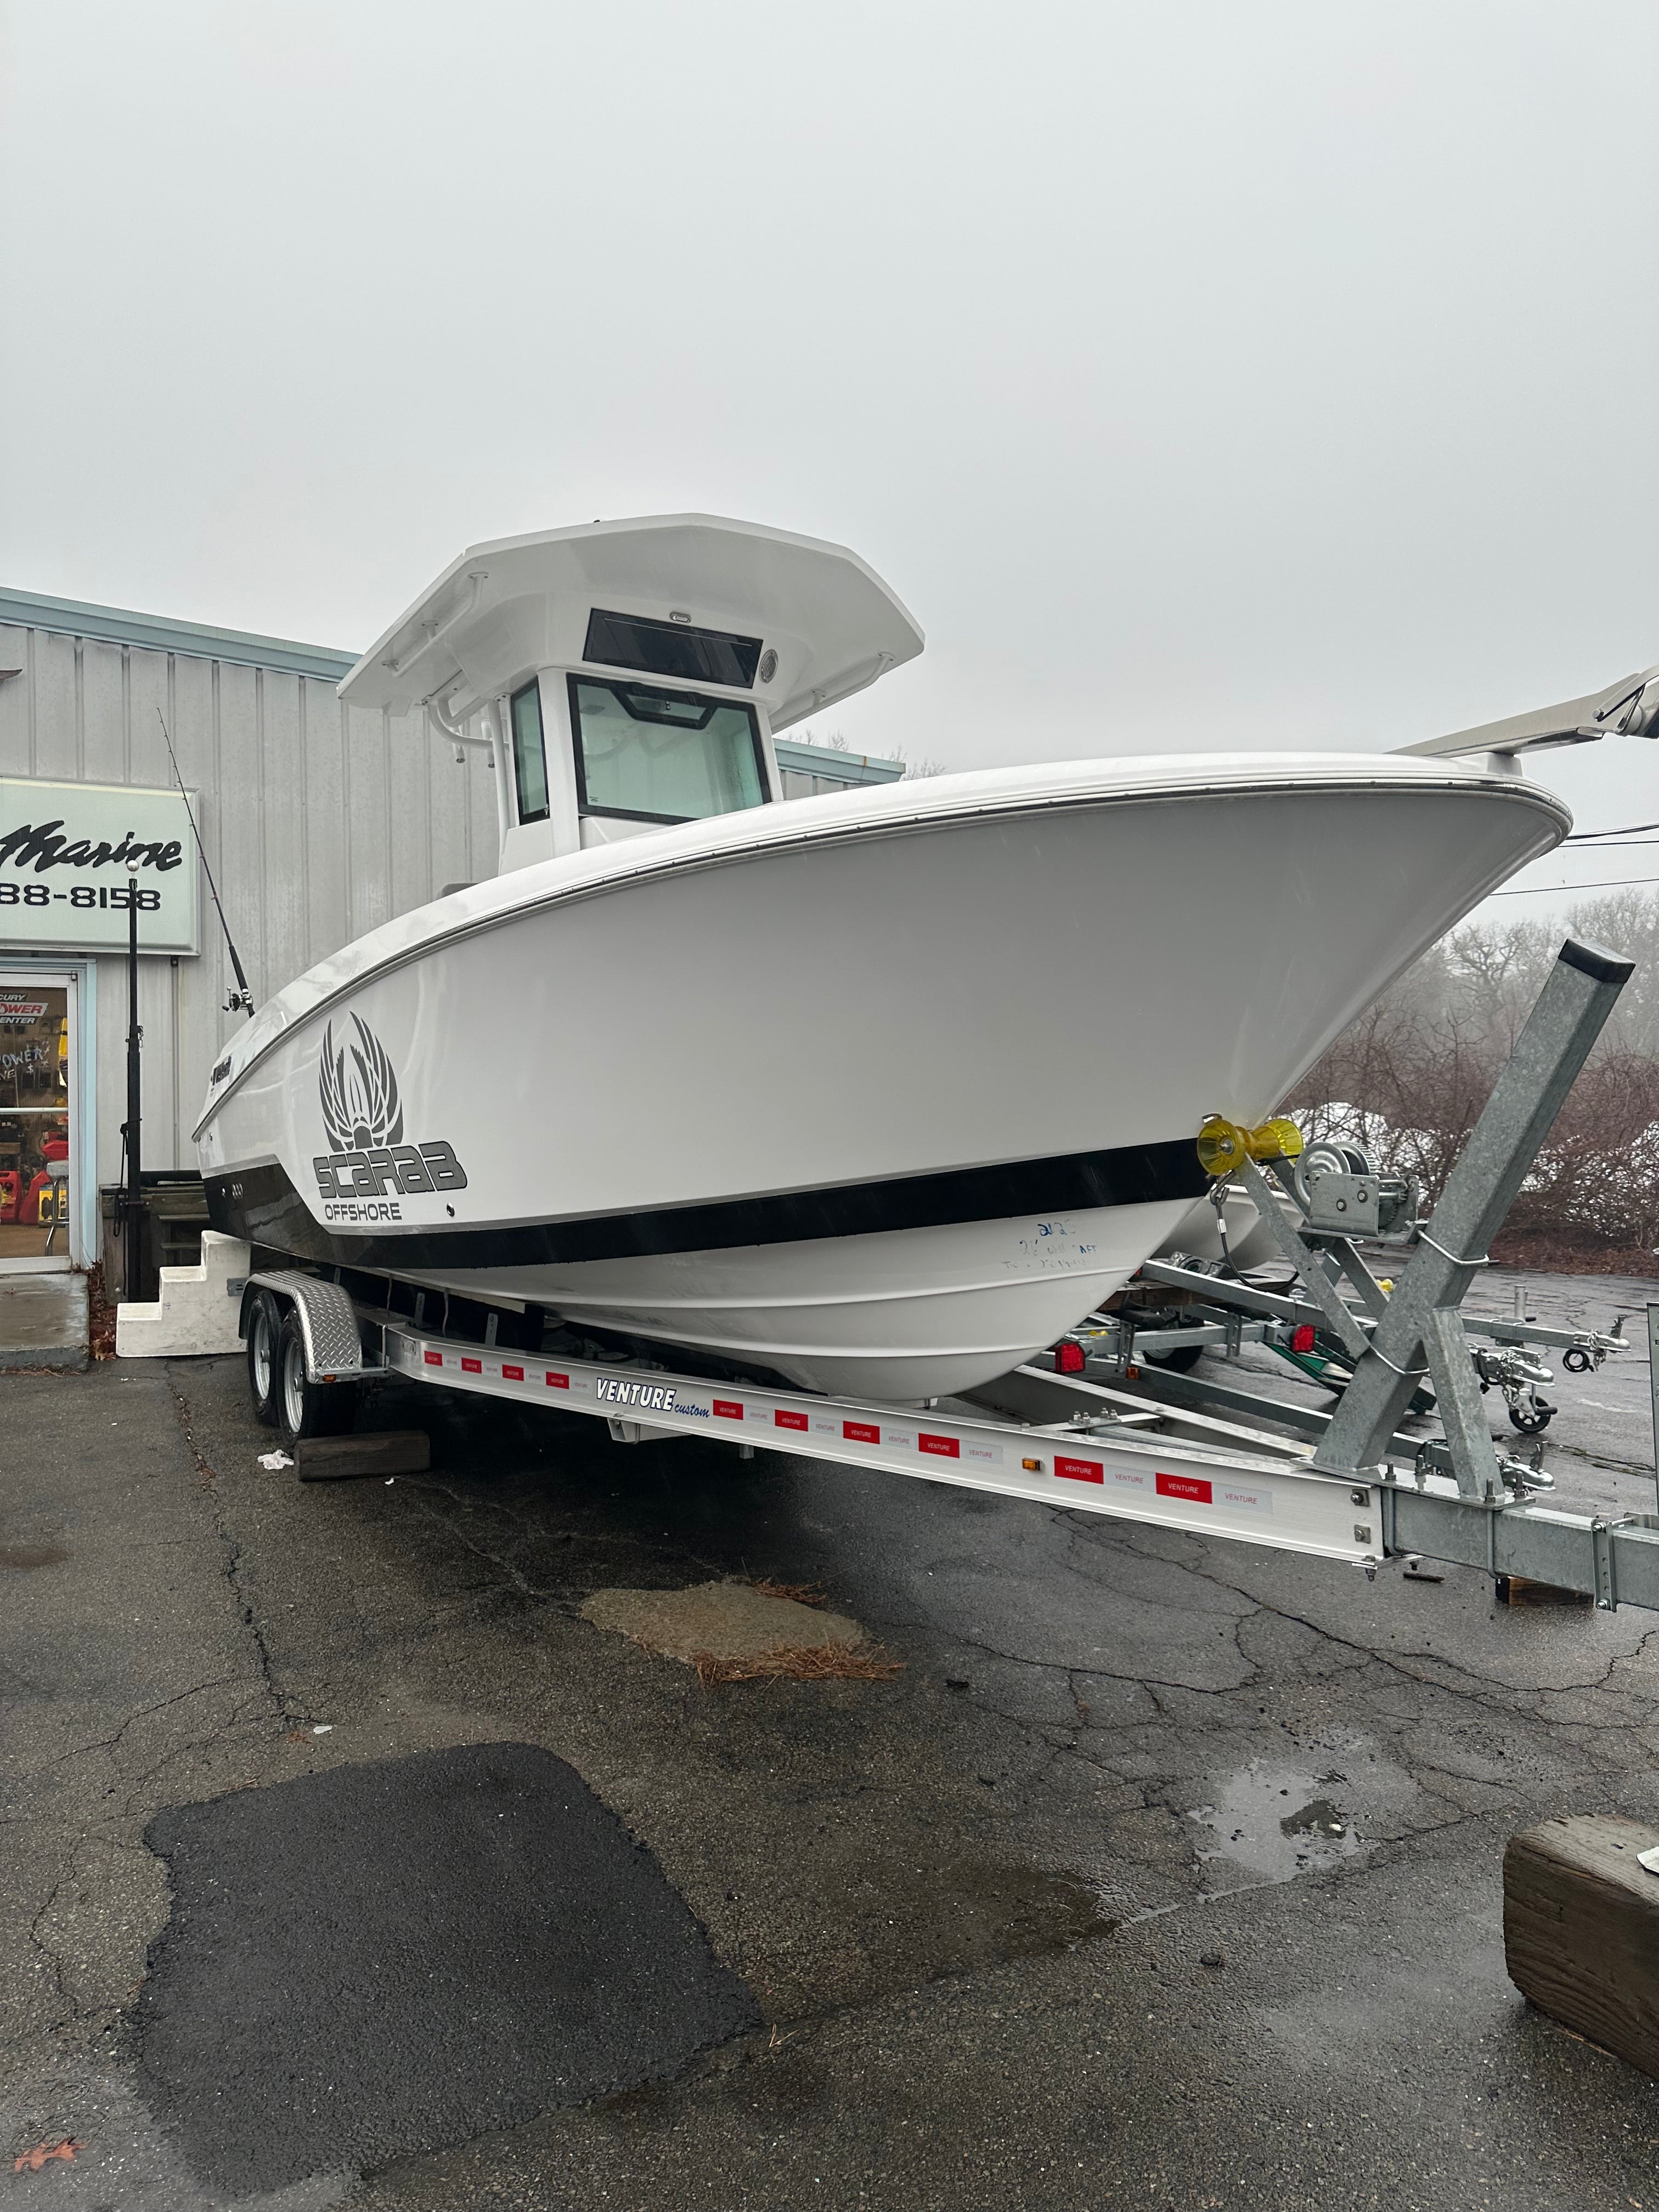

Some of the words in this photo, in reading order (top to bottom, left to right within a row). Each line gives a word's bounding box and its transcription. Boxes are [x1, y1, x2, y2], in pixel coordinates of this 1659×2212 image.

[0, 820, 182, 872] Marine
[325, 1203, 402, 1221] OFFSHORE
[597, 1378, 677, 1412] VENTURE
[675, 1403, 710, 1418] custom
[719, 1407, 737, 1415] VENTURE
[750, 1412, 768, 1420] VENTURE
[782, 1418, 801, 1426] VENTURE
[815, 1423, 836, 1431] VENTURE
[850, 1429, 872, 1438] VENTURE
[888, 1435, 910, 1444] VENTURE
[927, 1442, 951, 1452] VENTURE
[968, 1449, 992, 1459] VENTURE
[1064, 1464, 1092, 1476] VENTURE
[1115, 1473, 1144, 1484] VENTURE
[1167, 1482, 1199, 1494] VENTURE
[1224, 1492, 1258, 1505] VENTURE
